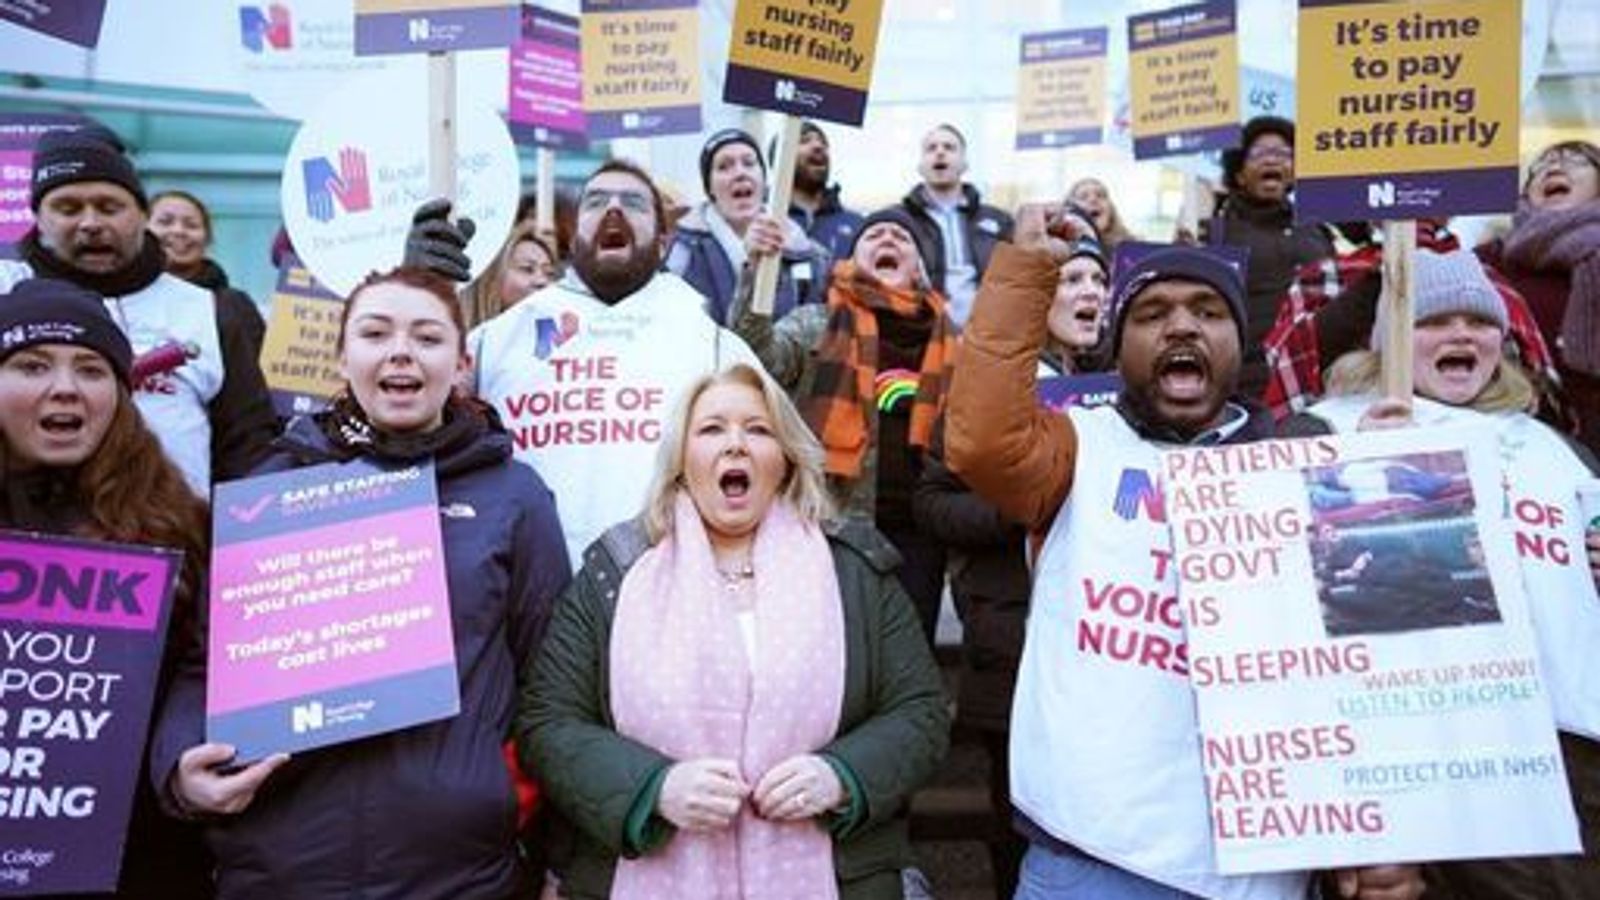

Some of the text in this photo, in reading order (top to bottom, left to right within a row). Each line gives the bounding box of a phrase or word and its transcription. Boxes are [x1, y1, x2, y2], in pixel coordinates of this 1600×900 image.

[765, 5, 854, 42] nursing
[1336, 13, 1480, 46] It's time
[611, 41, 669, 57] to pay
[744, 29, 864, 72] staff fairly
[1353, 53, 1462, 83] to pay
[1339, 84, 1475, 115] nursing
[1315, 118, 1500, 151] staff fairly
[548, 356, 618, 383] THE
[506, 386, 664, 420] VOICE OF
[511, 418, 662, 451] NURSING
[1167, 440, 1338, 480] PATIENTS
[281, 466, 421, 502] SAFE STAFFING
[1173, 481, 1239, 515] ARE
[1184, 507, 1300, 547] DYING
[1515, 499, 1564, 529] OF
[255, 536, 398, 574] Will there be
[1181, 546, 1282, 583] GOVT
[0, 559, 149, 617] ONK
[221, 547, 433, 600] enough staff when
[243, 567, 415, 621] you need care?
[1188, 596, 1221, 627] IS
[319, 604, 434, 640] shortages
[2, 629, 96, 665] YOU
[277, 635, 387, 671] cost lives
[1193, 643, 1370, 687] SLEEPING
[0, 667, 123, 703] PORT
[1363, 658, 1537, 690] WAKE UP NOW!
[1336, 691, 1409, 716] LISTEN
[1414, 689, 1446, 708] TO
[18, 706, 113, 740] PAY
[1206, 724, 1356, 769] NURSES
[1214, 766, 1288, 803] ARE
[1343, 753, 1558, 786] PROTECT OUR NHS!
[1215, 800, 1384, 839] LEAVING
[3, 848, 55, 867] College
